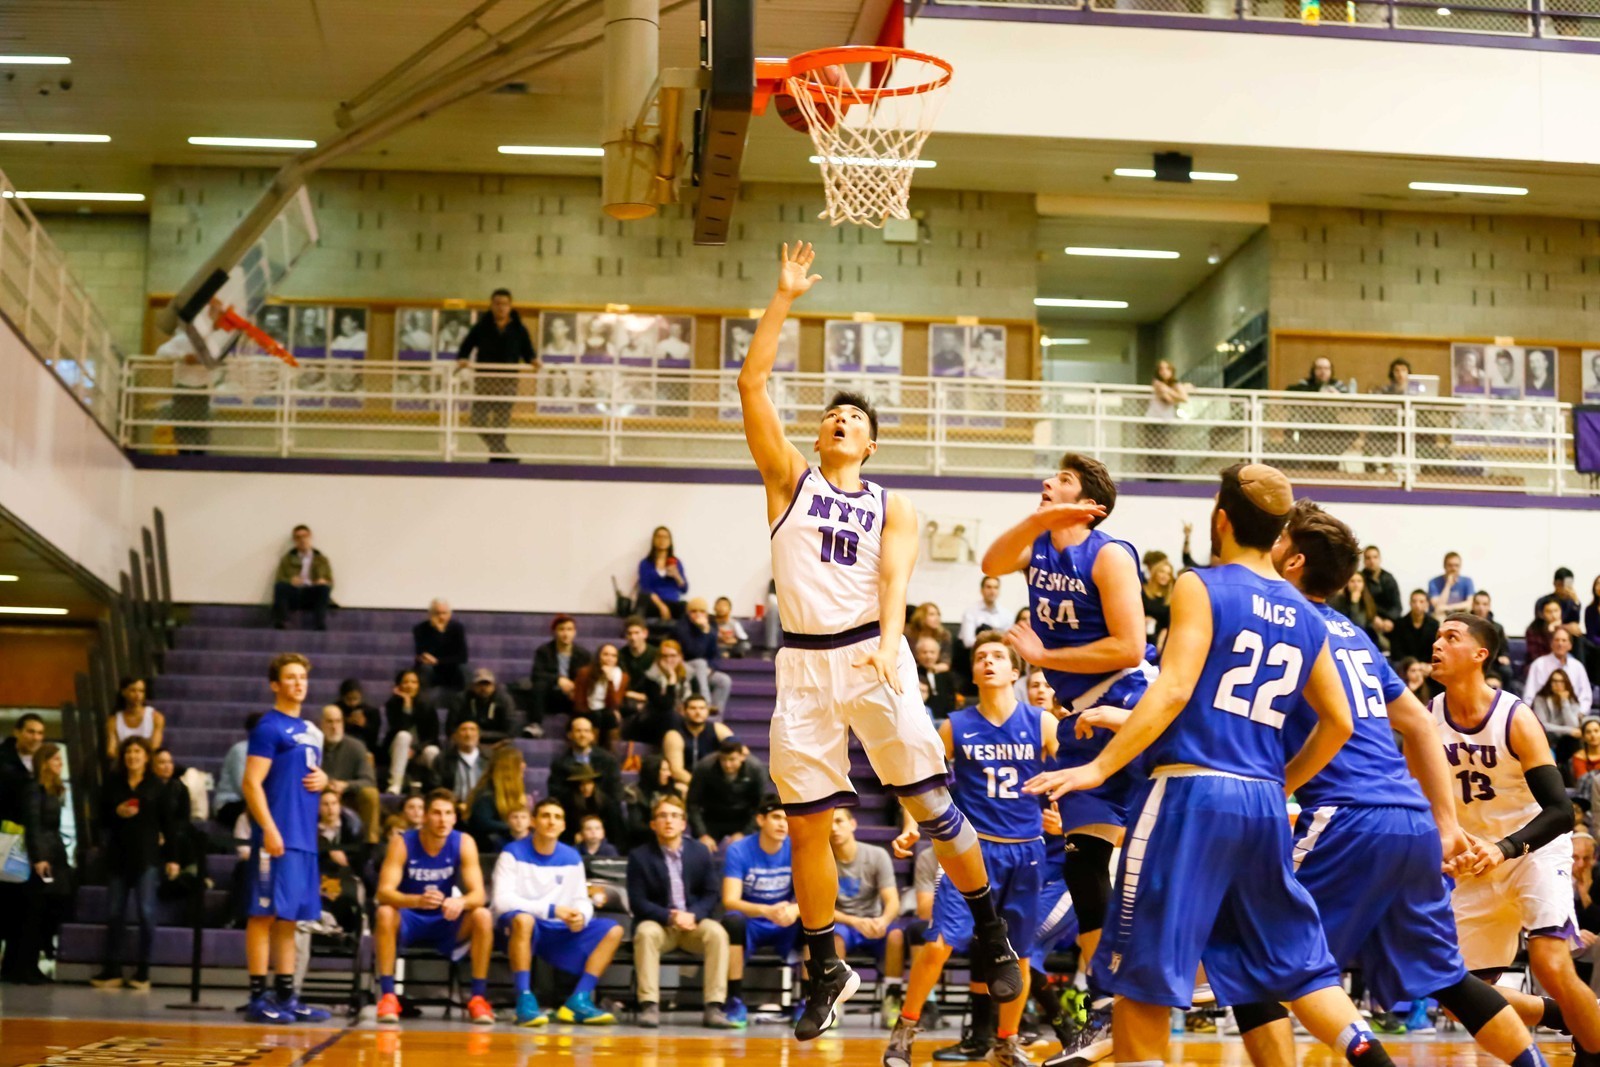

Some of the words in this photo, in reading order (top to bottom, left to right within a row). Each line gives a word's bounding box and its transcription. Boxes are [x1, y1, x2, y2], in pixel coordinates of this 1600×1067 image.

[807, 494, 876, 533] NYU
[818, 526, 860, 566] 10
[1028, 565, 1088, 596] YESHIVA
[1036, 596, 1080, 631] 44
[1252, 594, 1297, 628] MACS
[1213, 629, 1304, 730] 22
[1335, 648, 1388, 718] 15
[961, 743, 1035, 761] YESHIVA
[1442, 742, 1498, 769] NYU
[982, 766, 1019, 799] 12
[1455, 769, 1497, 805] 13
